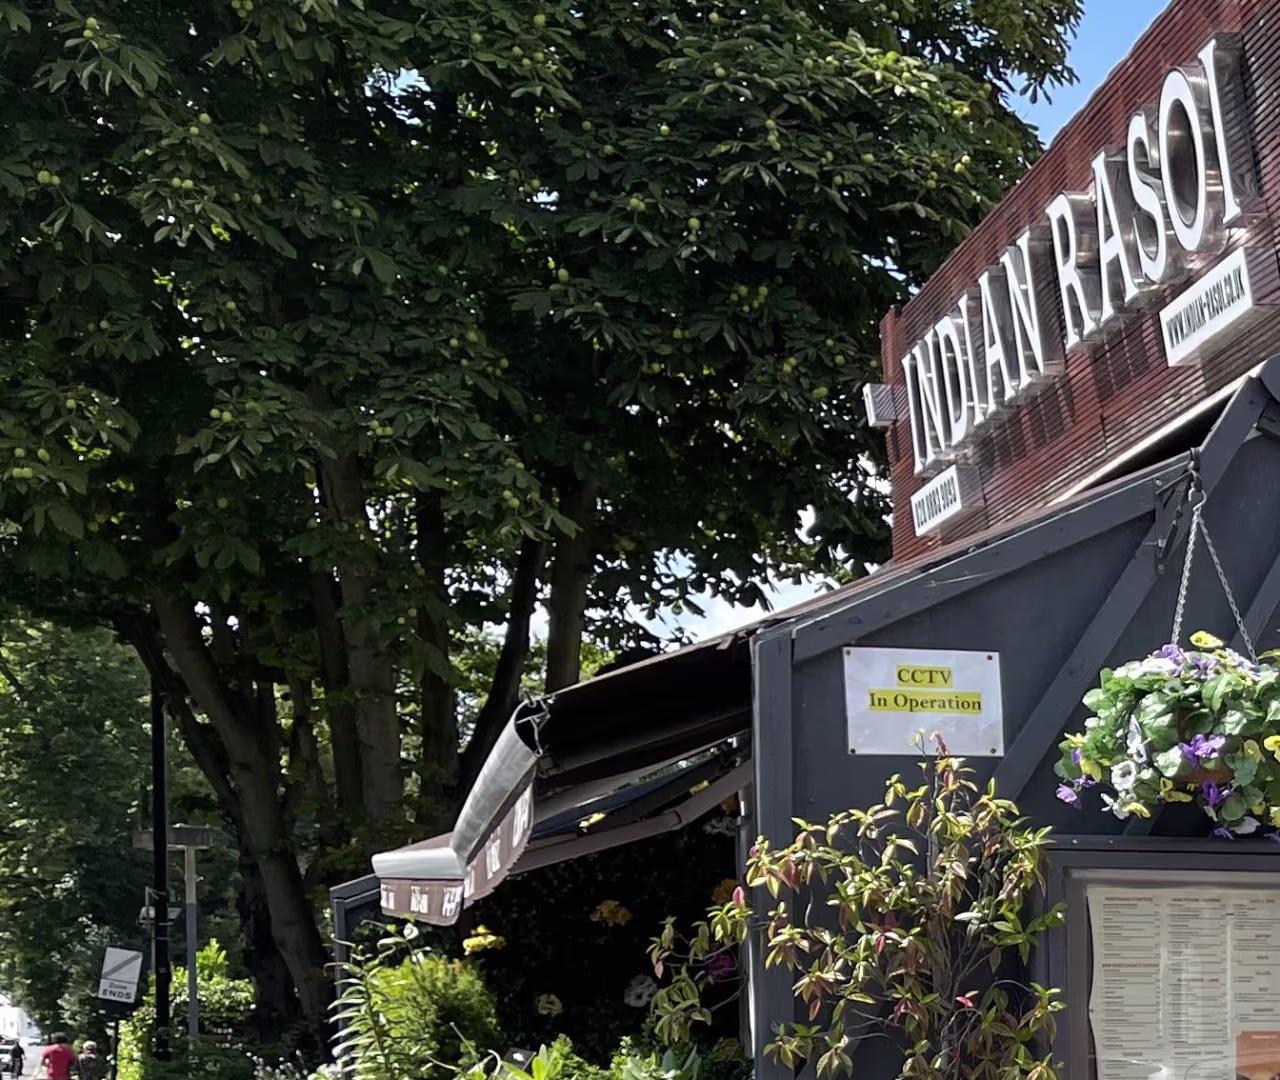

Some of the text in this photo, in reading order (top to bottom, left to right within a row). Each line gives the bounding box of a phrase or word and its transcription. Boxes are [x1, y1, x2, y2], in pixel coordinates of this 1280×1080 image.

[902, 39, 1241, 474] INDIAN RASOI
[897, 668, 952, 684] CCTV
[869, 692, 982, 713] In Operation
[102, 988, 132, 1000] ENDS
